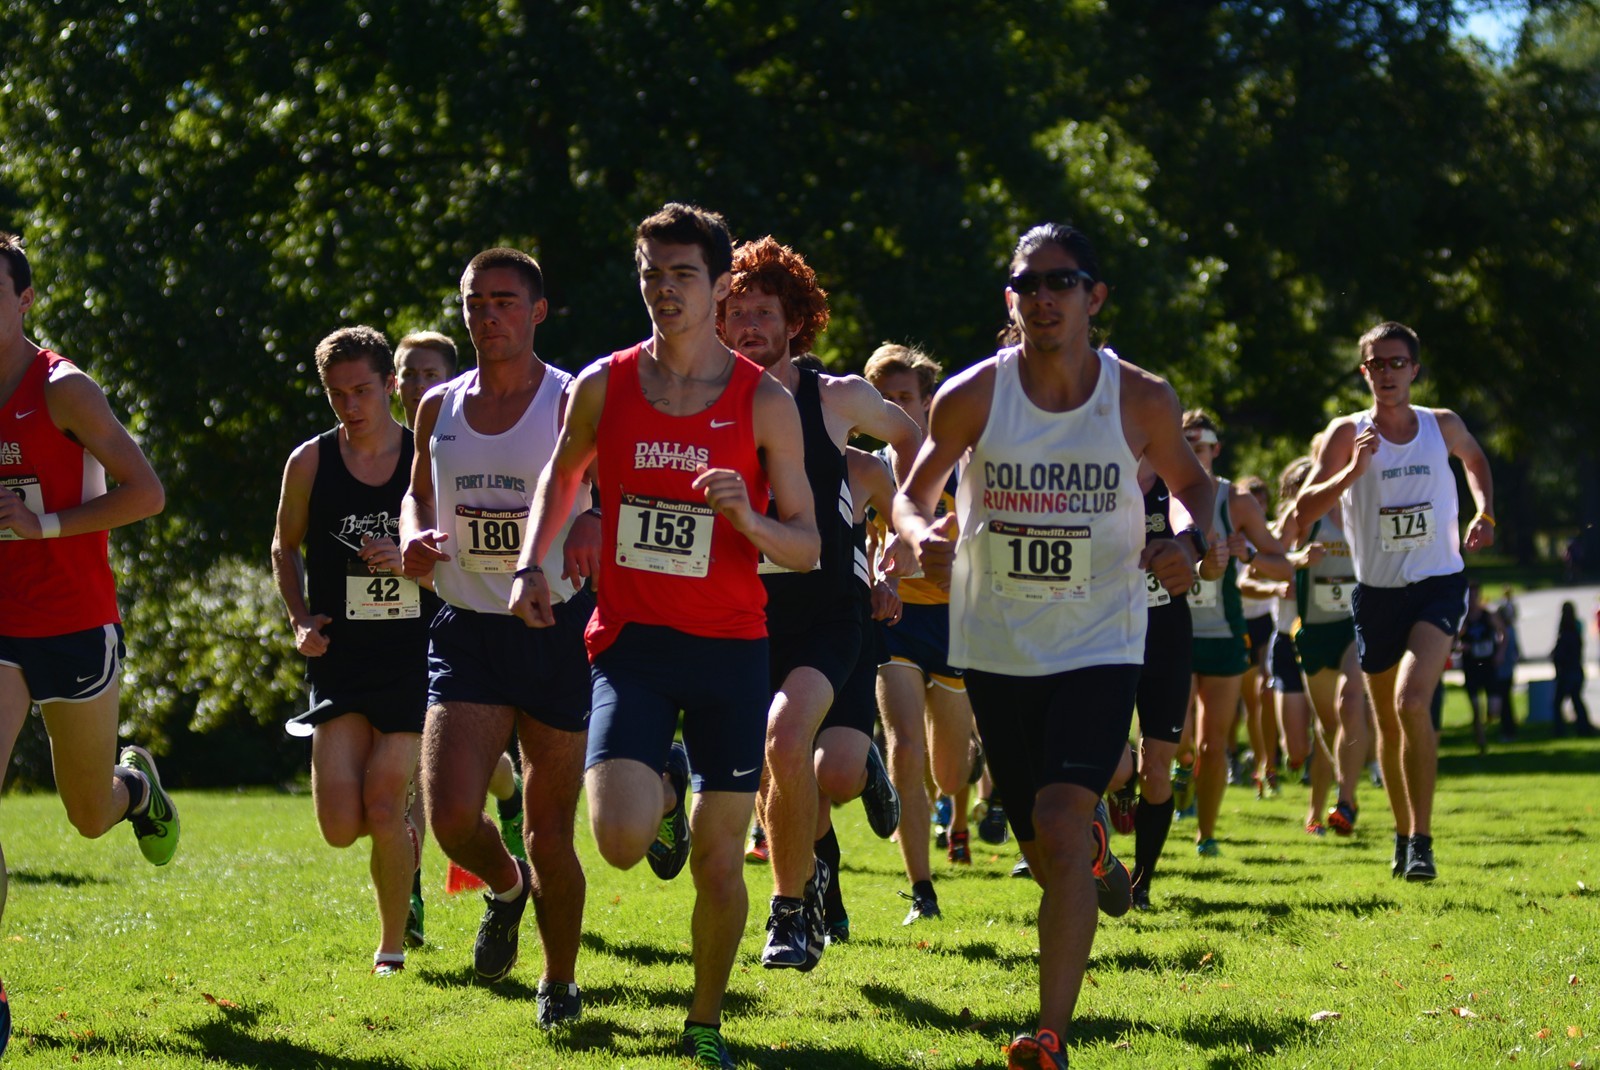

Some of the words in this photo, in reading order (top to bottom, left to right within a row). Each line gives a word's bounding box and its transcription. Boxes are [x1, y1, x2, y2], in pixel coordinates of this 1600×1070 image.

[0, 442, 20, 454] AS
[634, 442, 709, 462] DALLAS
[0, 454, 22, 465] IST
[984, 461, 1120, 491] COLORADO
[1382, 467, 1402, 480] FORT
[1403, 465, 1431, 476] LEWIS
[455, 474, 485, 491] FORT
[487, 474, 526, 493] LEWIS
[656, 501, 713, 514] RoadID.com
[638, 510, 696, 549] 153
[1026, 527, 1089, 537] RoadID.com
[1392, 512, 1427, 535] 174
[468, 520, 520, 550] 180
[1008, 538, 1072, 575] 108
[366, 578, 400, 602] 42
[1332, 585, 1342, 600] 9
